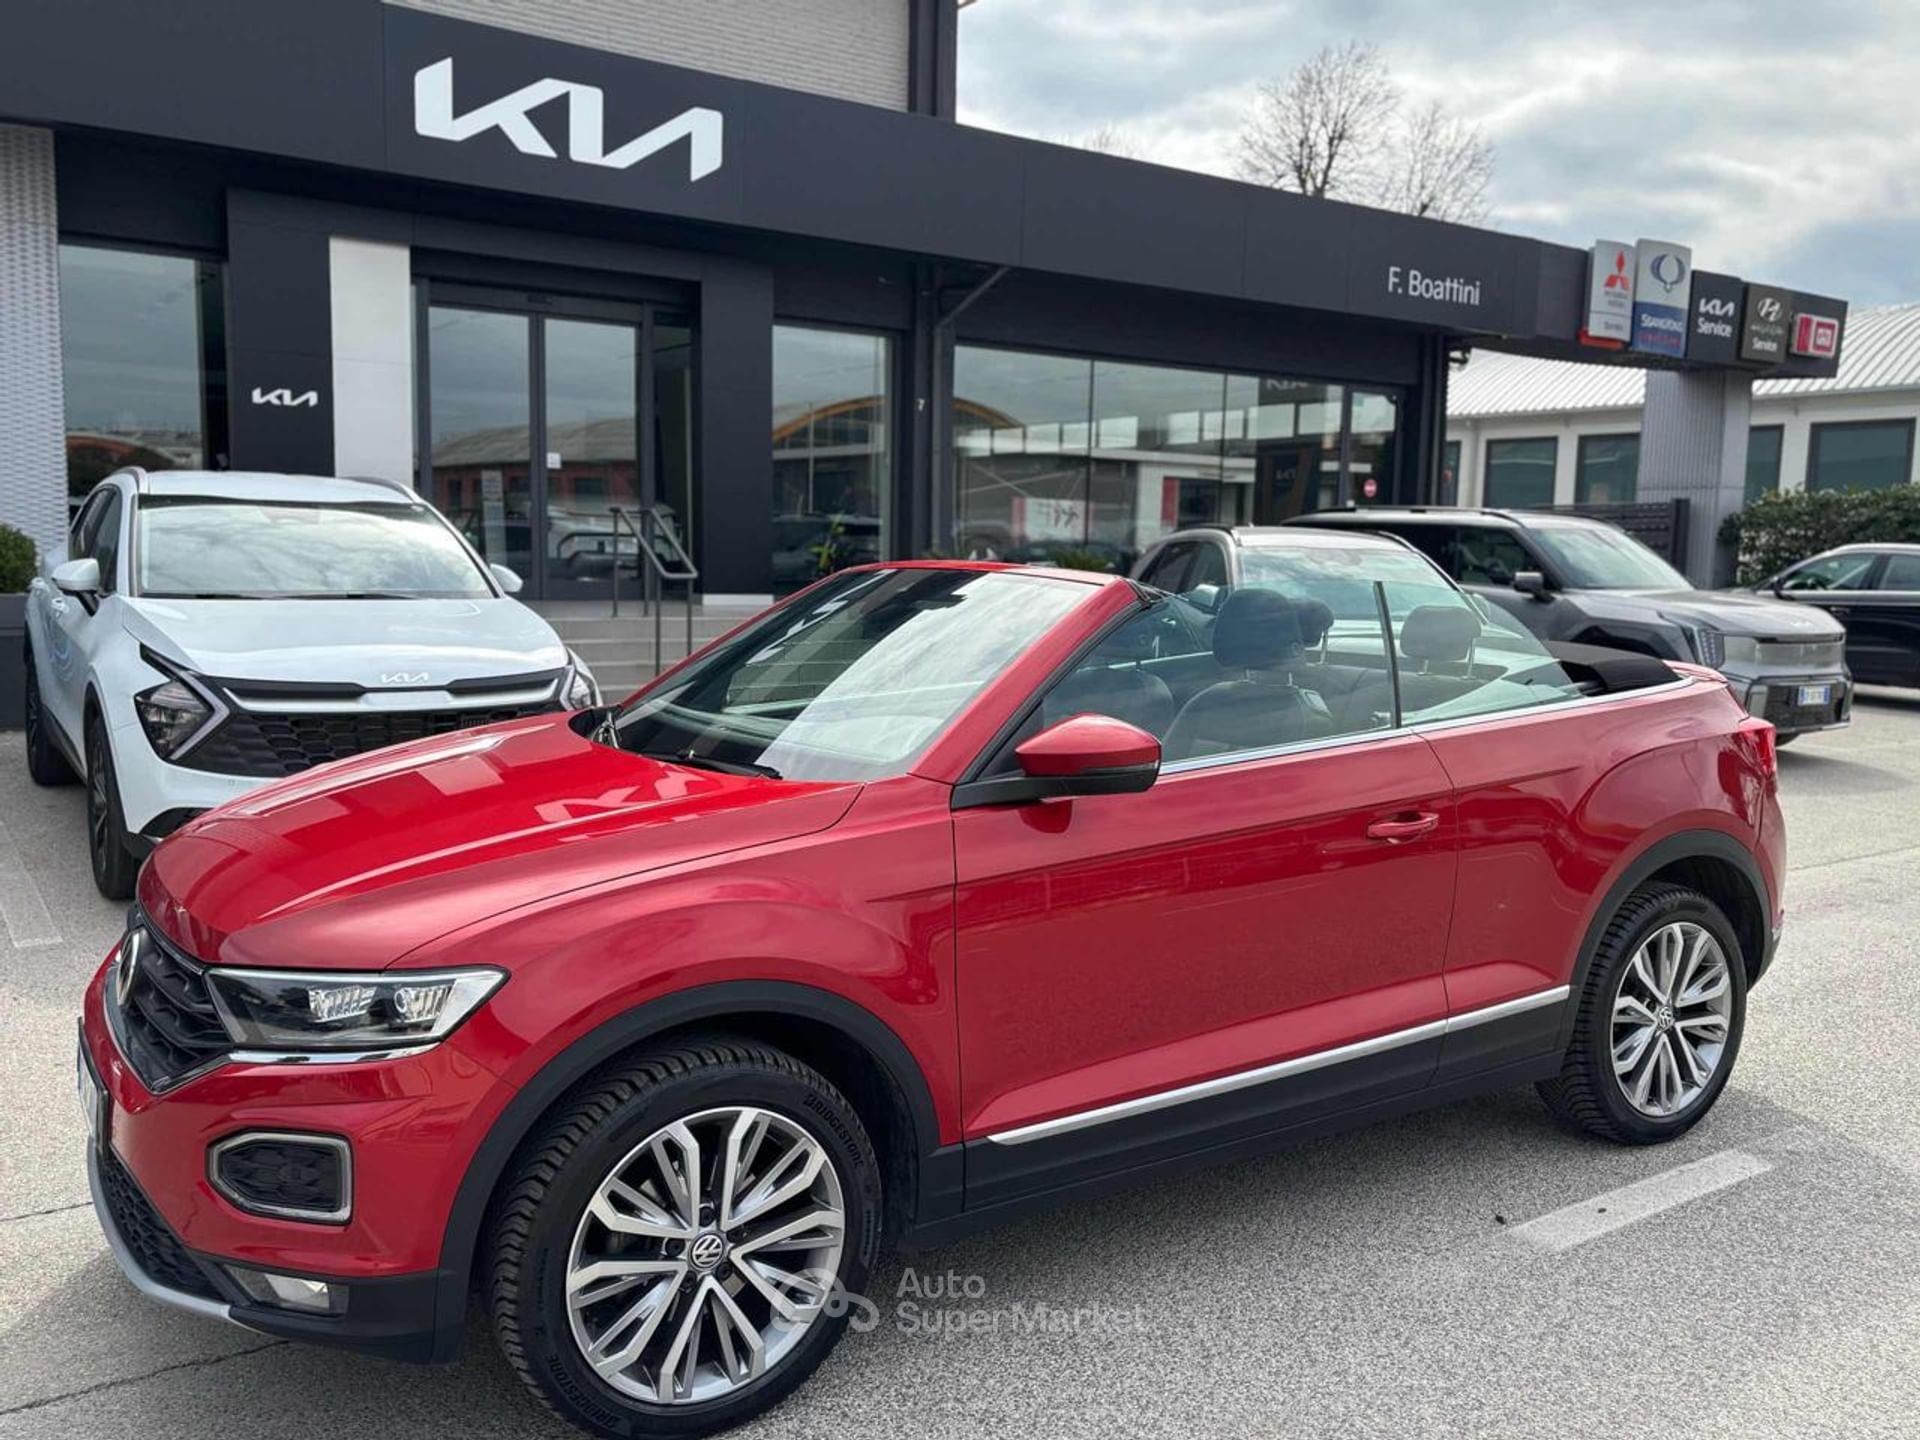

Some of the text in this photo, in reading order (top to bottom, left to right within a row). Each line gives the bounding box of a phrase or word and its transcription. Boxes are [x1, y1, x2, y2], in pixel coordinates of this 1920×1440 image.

[414, 57, 723, 181] KIA
[1387, 265, 1481, 306] F. Boattini
[1696, 317, 1733, 338] Service
[1751, 337, 1778, 353] Service
[251, 387, 319, 407] KIA
